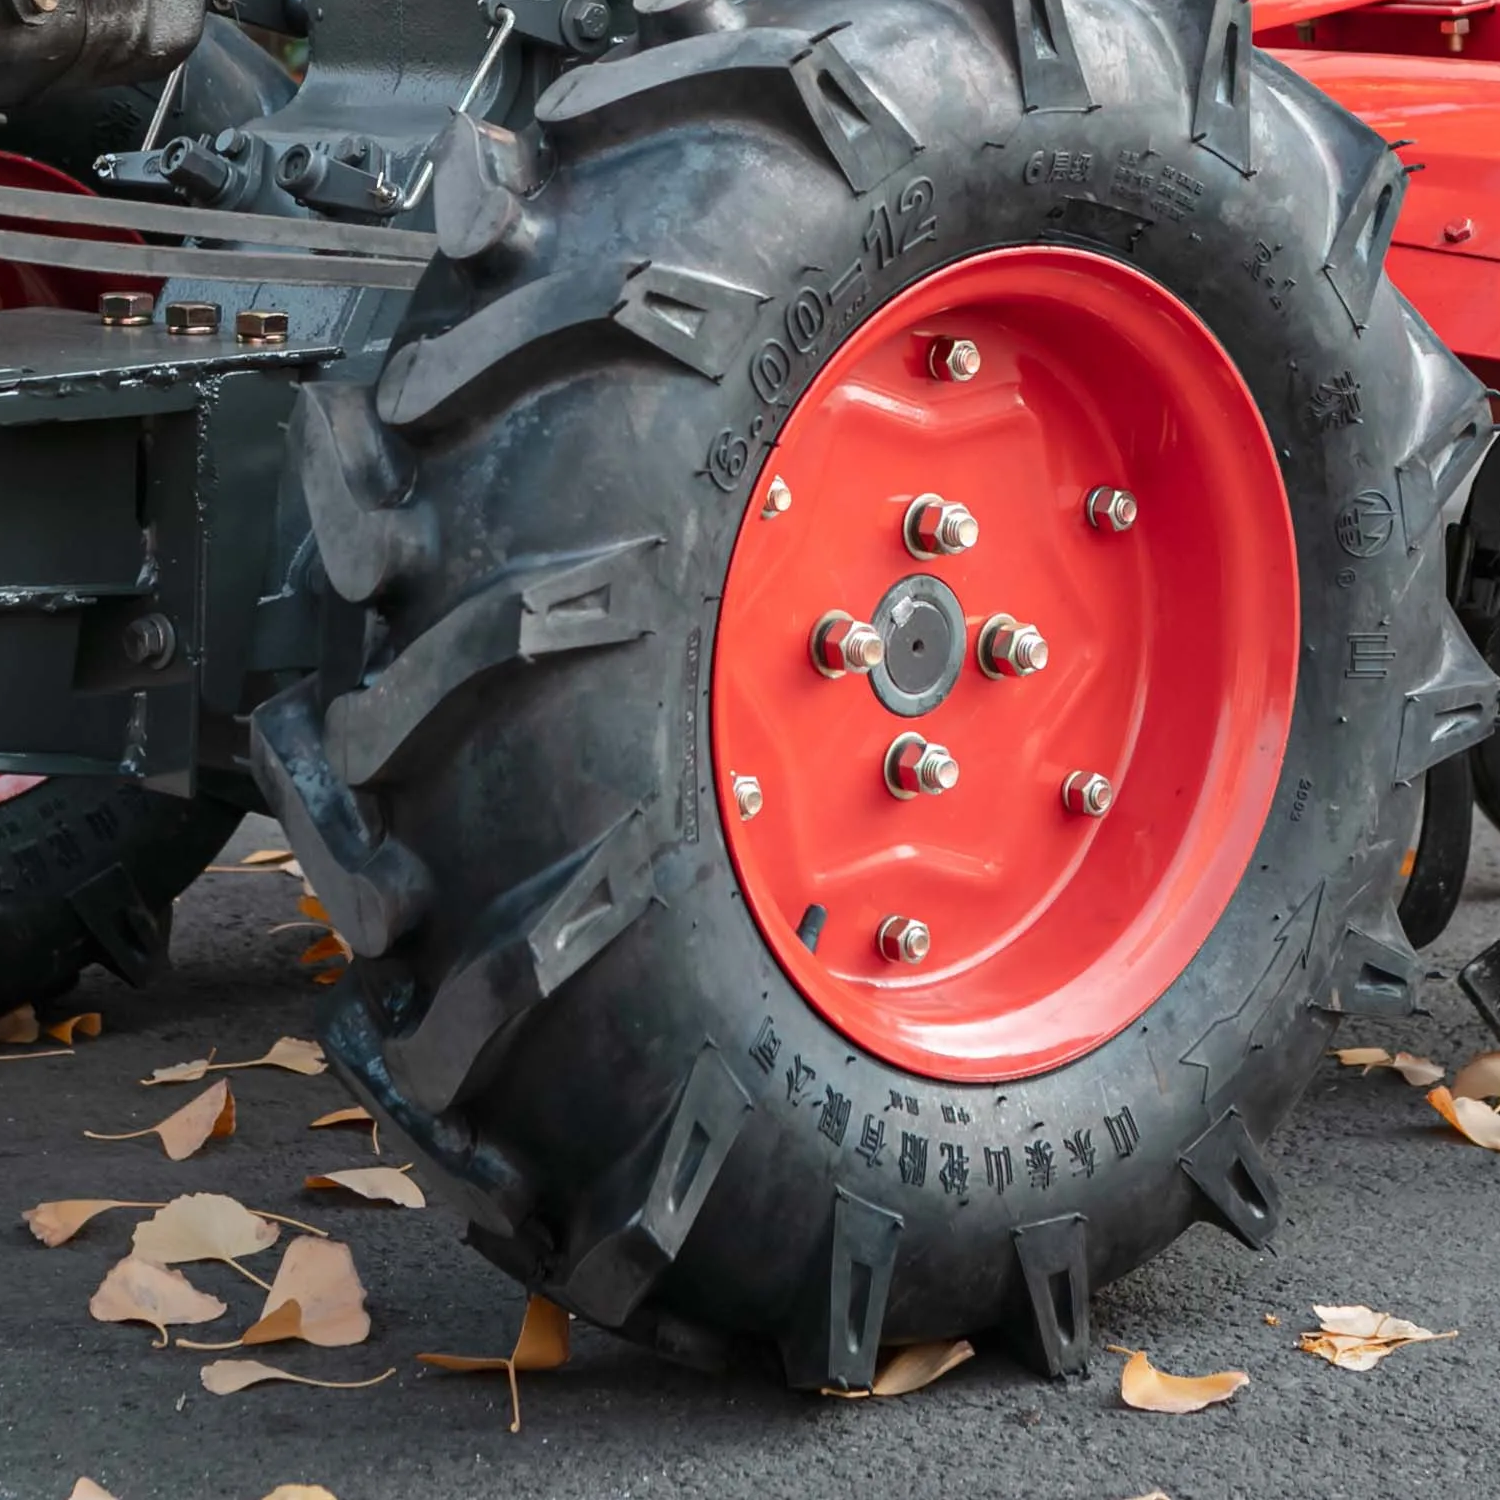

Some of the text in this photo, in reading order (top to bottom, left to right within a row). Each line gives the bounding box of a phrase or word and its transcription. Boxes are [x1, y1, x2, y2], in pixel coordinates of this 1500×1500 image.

[749, 1015, 1140, 1195] 山东泰山轮胎有限公司
